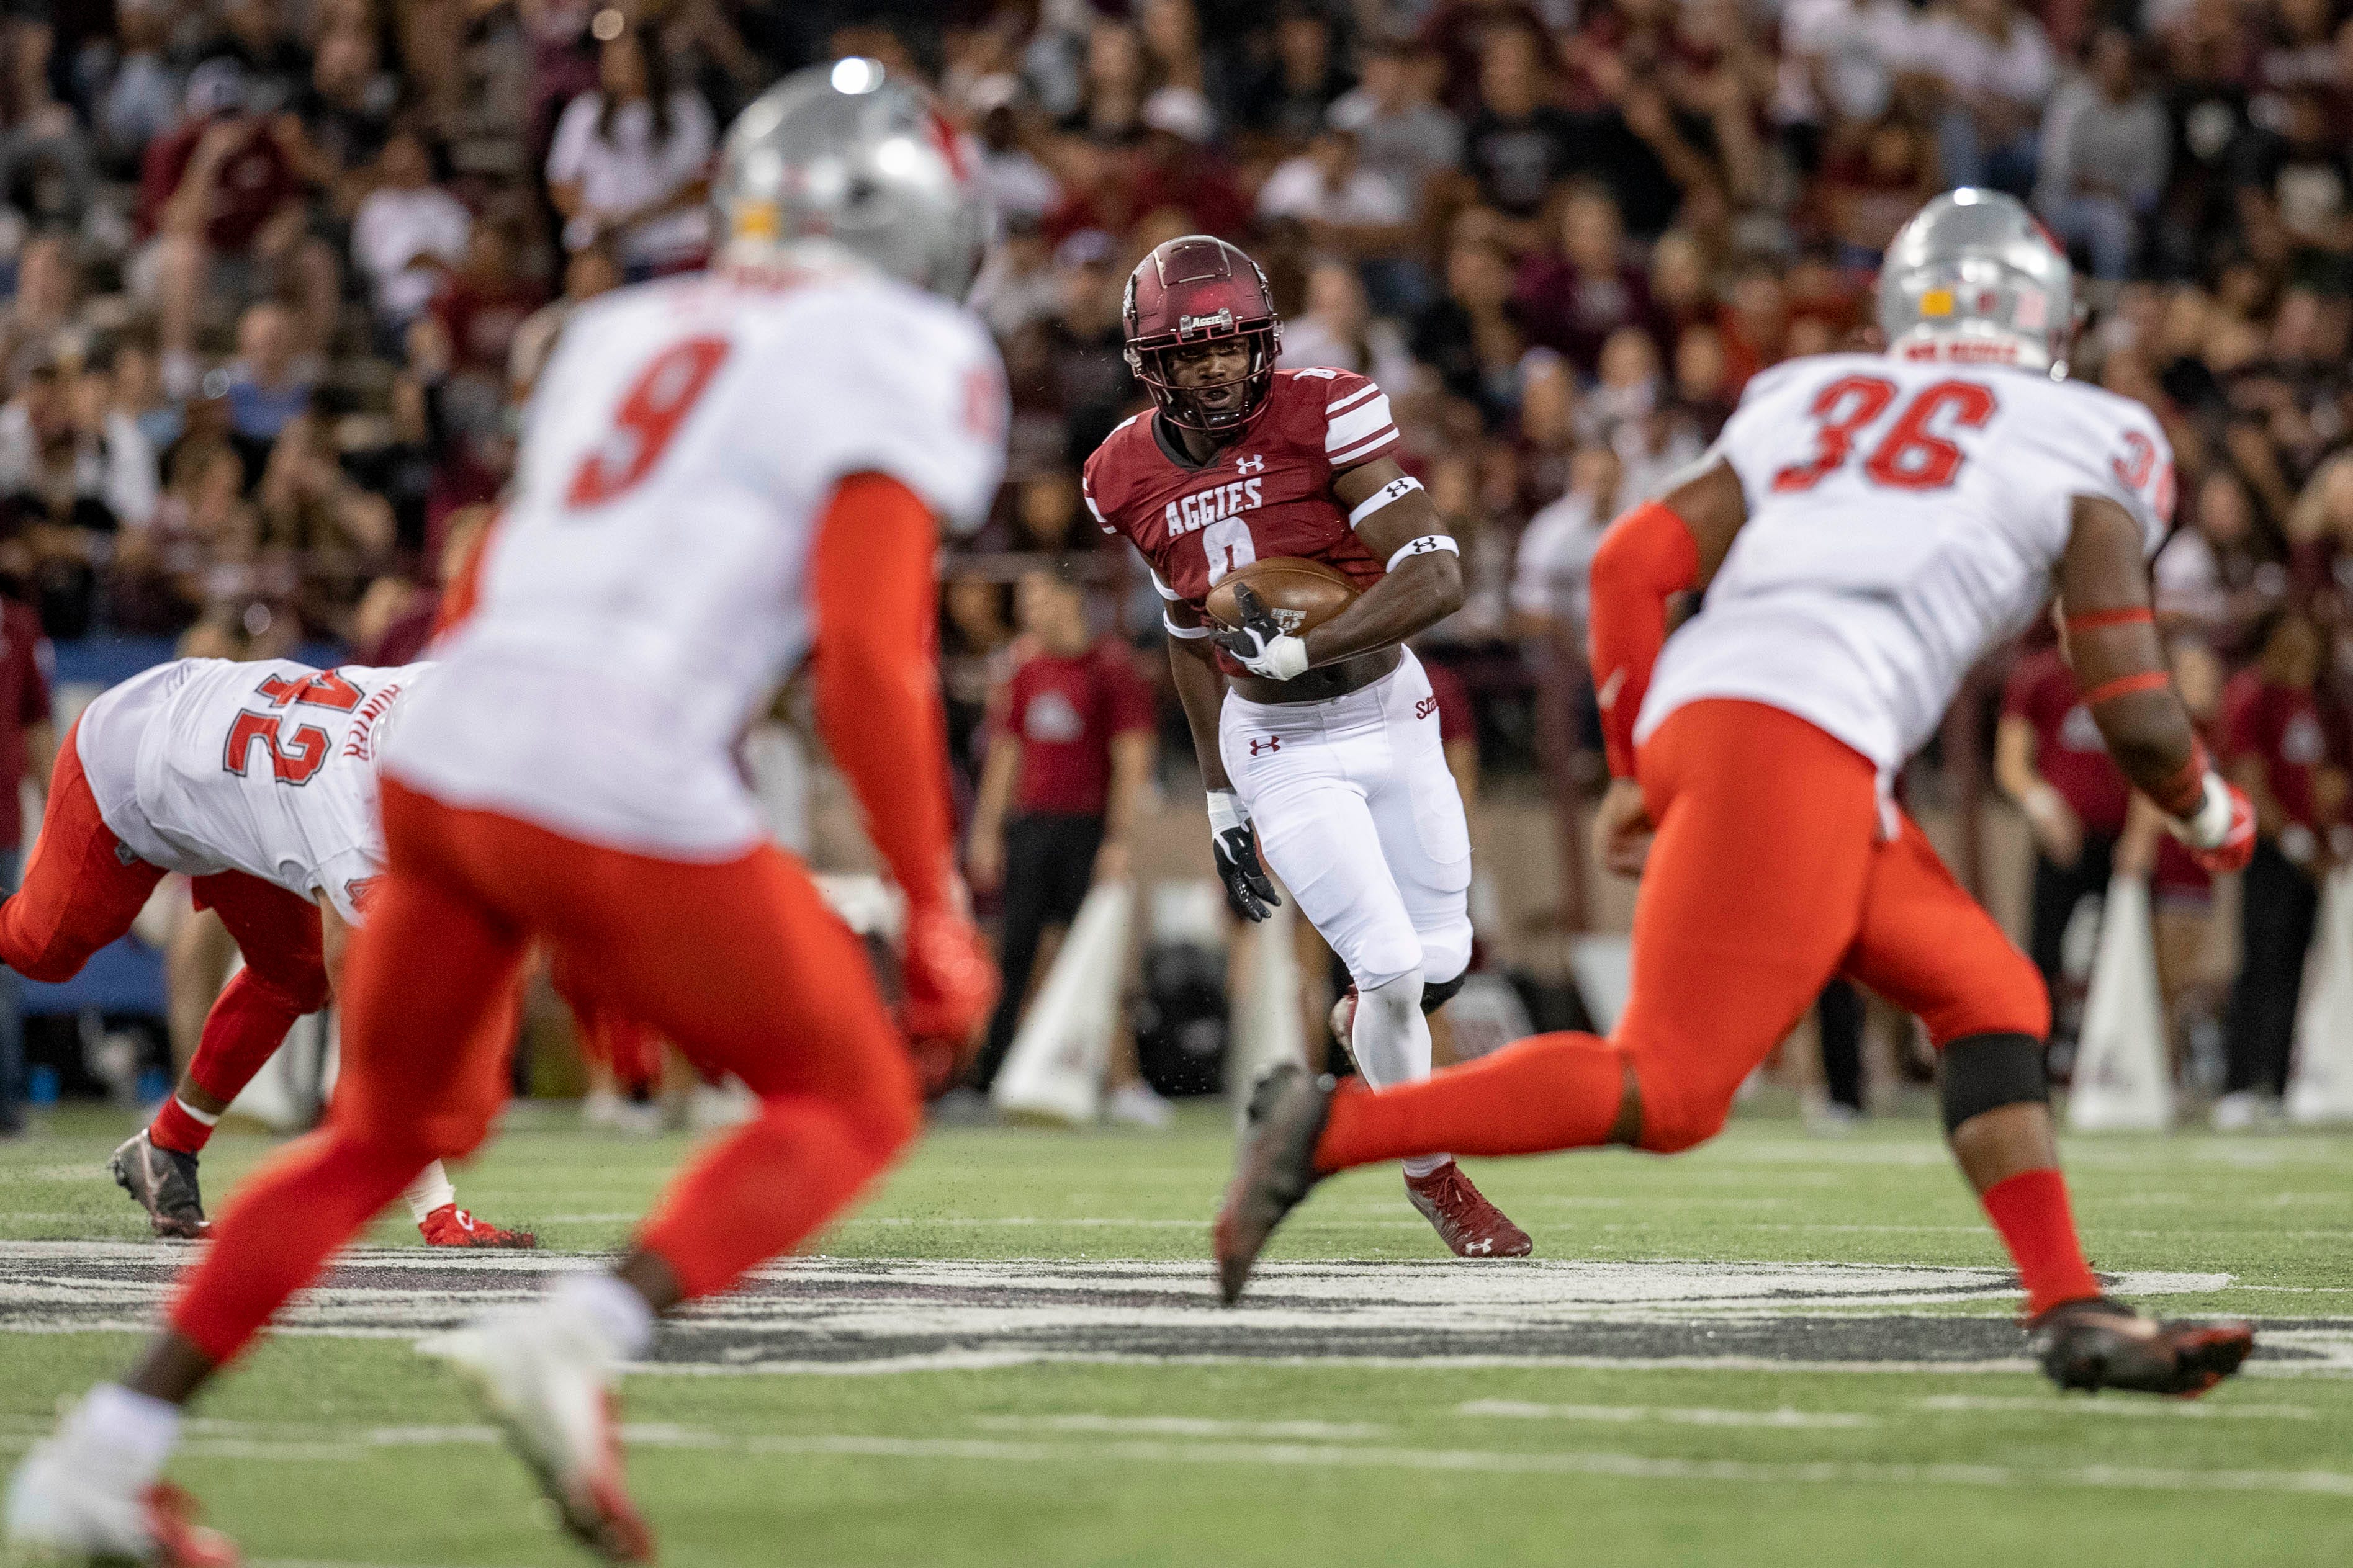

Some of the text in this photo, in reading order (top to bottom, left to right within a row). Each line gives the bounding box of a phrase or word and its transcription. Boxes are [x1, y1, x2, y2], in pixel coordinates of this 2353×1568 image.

[1191, 313, 1228, 328] AGGIE
[565, 330, 734, 511] 9
[1770, 374, 1999, 494] 36
[1165, 477, 1262, 537] AGGIES
[223, 669, 366, 787] 42
